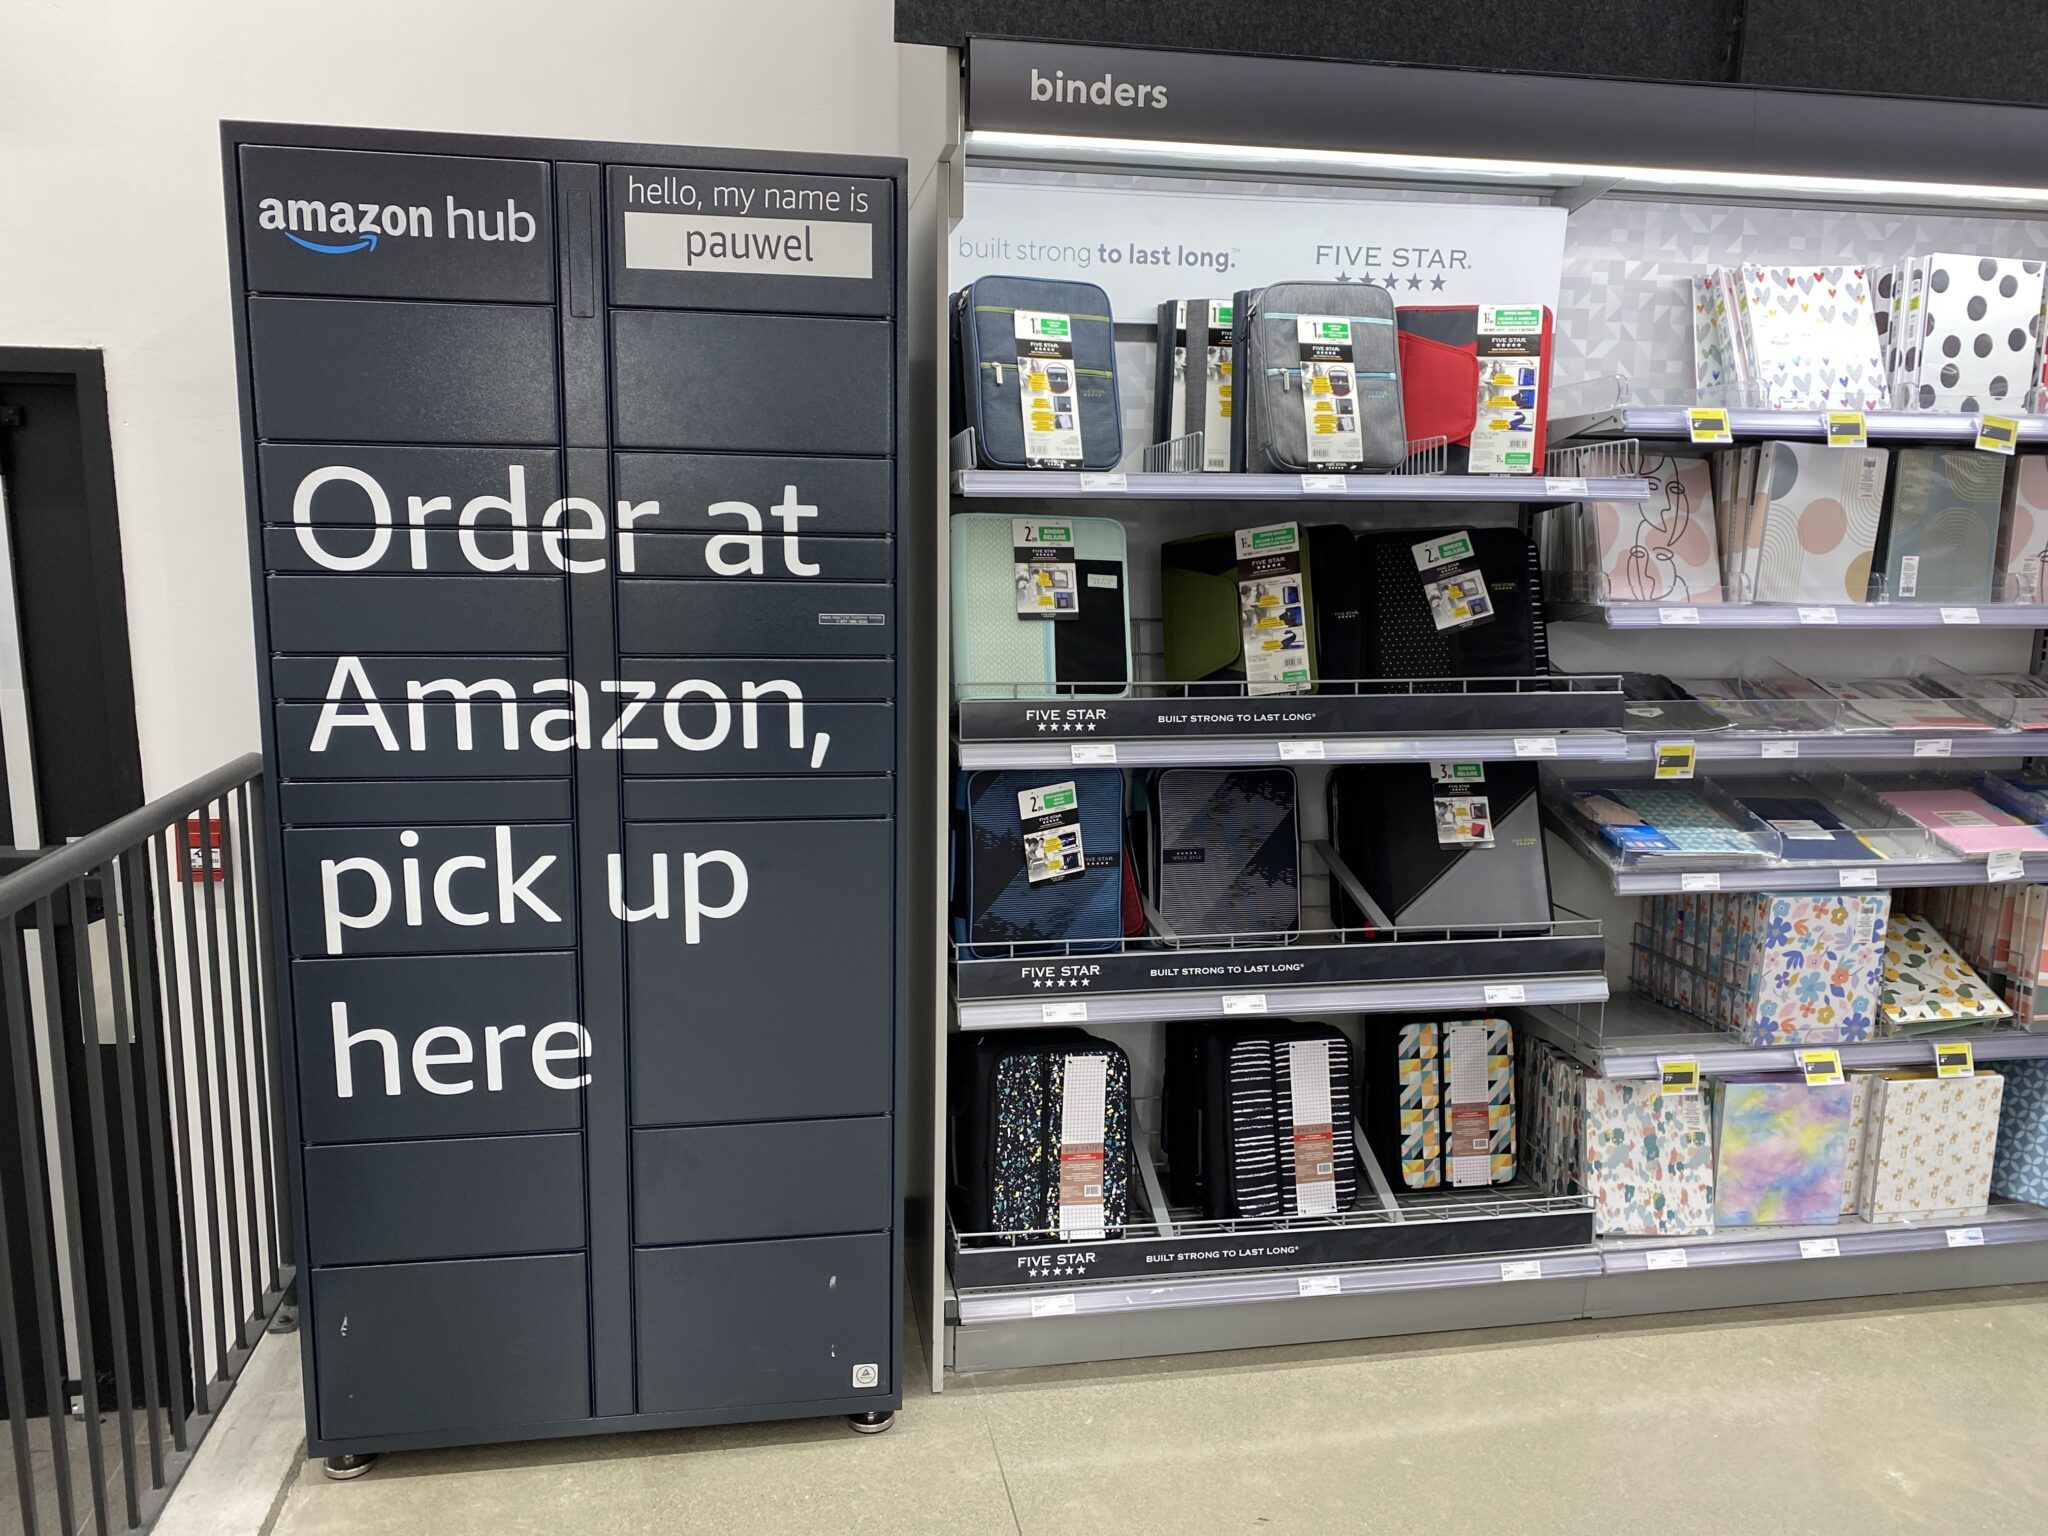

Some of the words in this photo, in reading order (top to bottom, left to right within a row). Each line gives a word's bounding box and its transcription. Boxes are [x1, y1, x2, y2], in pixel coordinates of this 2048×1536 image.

[1031, 69, 1167, 108] binders
[630, 176, 701, 210] hello,
[714, 187, 755, 214] my
[766, 189, 839, 211] name
[851, 186, 868, 212] is
[259, 198, 432, 238] amazon
[447, 196, 535, 242] hub
[687, 226, 813, 266] pauwel
[960, 237, 1009, 259] built
[1017, 241, 1090, 268] strong
[1098, 244, 1122, 263] to
[1130, 244, 1170, 265] last
[1317, 246, 1381, 266] FIVE
[293, 464, 659, 573] Order
[705, 485, 819, 576] at
[310, 656, 830, 768] Amazon,
[1026, 709, 1061, 721] FIVE
[321, 825, 562, 955] pick
[608, 850, 748, 944] up
[1021, 967, 1056, 978] FIVE
[1182, 967, 1224, 975] STRONG
[332, 1002, 592, 1097] here
[1017, 1255, 1052, 1268] FIVE
[1147, 1254, 1174, 1262] BUILT
[1178, 1251, 1219, 1260] STRONG
[1239, 1248, 1264, 1256] LAST
